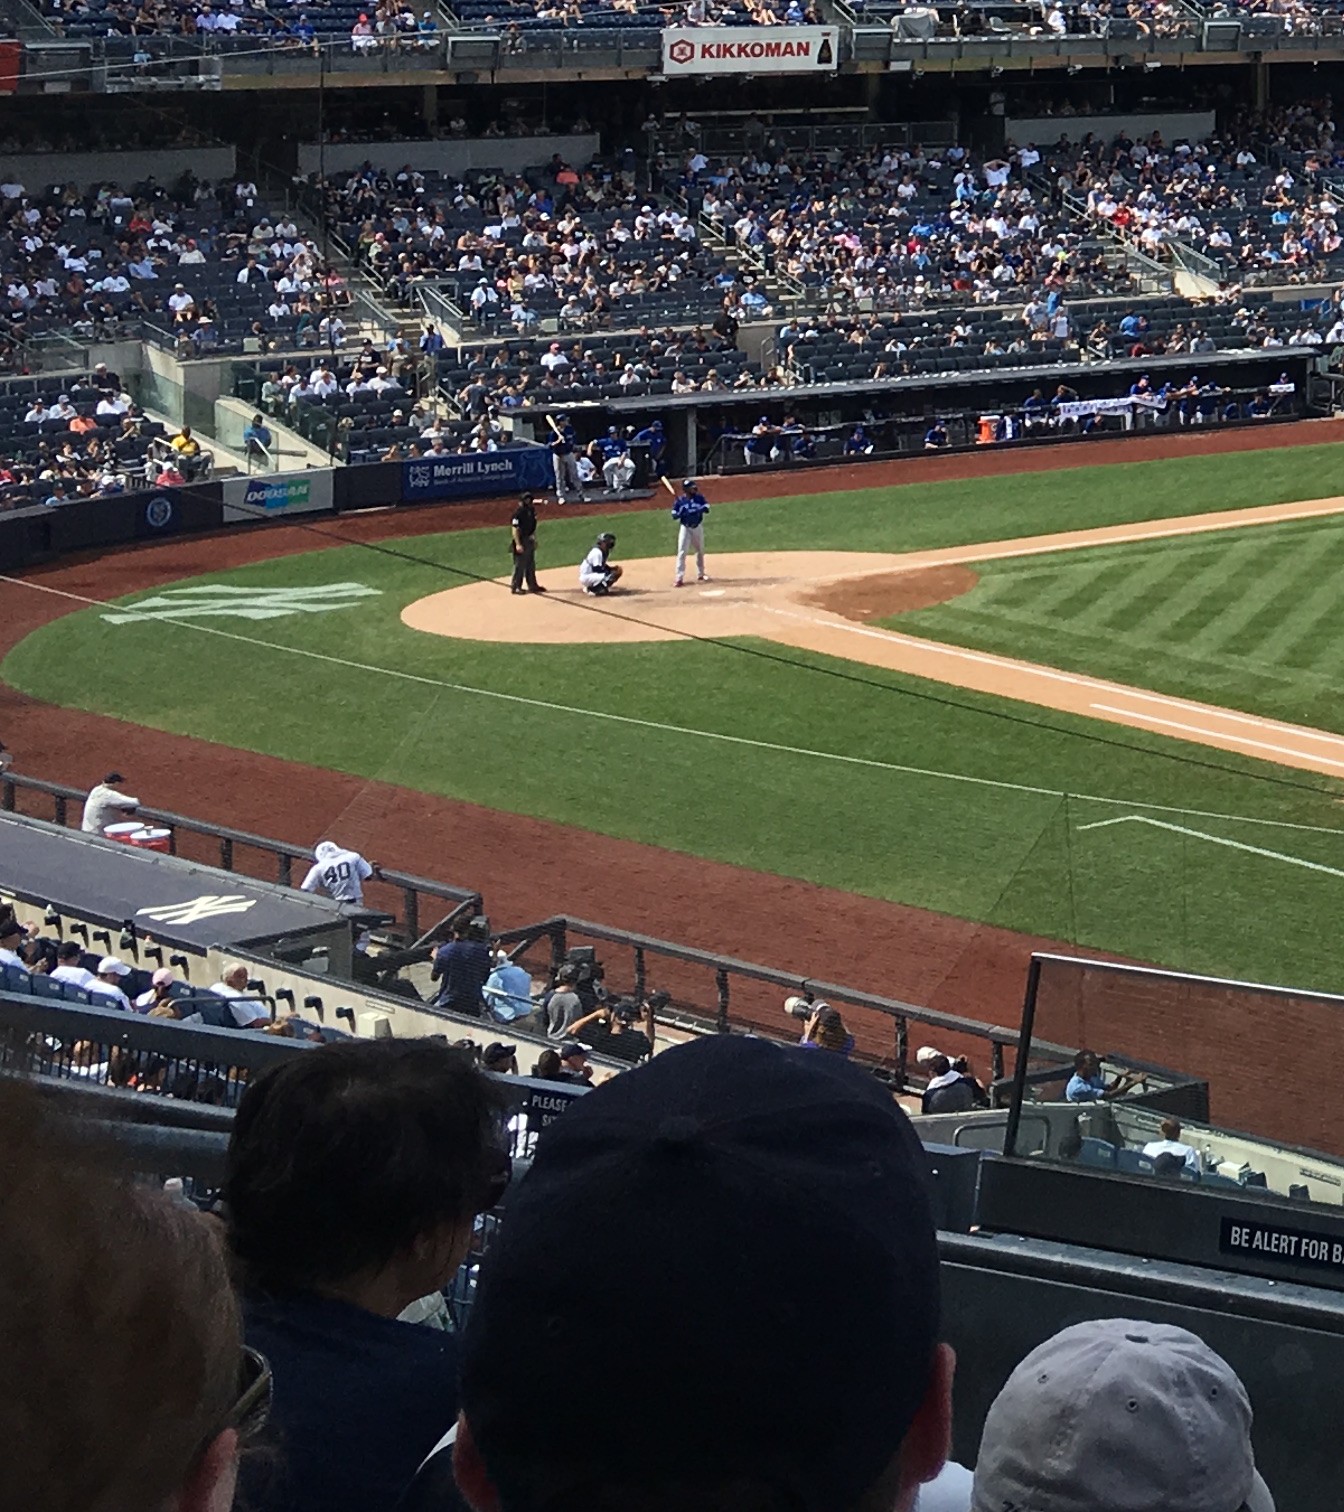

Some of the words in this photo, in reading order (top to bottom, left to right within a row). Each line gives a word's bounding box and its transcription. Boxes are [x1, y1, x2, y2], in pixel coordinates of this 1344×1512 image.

[701, 41, 810, 59] KIKKOMAN
[433, 461, 474, 477] Merrill
[477, 459, 513, 474] Lynch
[246, 484, 309, 502] DOOSAN
[324, 861, 351, 883] 40
[1230, 1226, 1250, 1247] BE
[1252, 1230, 1298, 1256] ALERT
[1301, 1237, 1328, 1261] FOR
